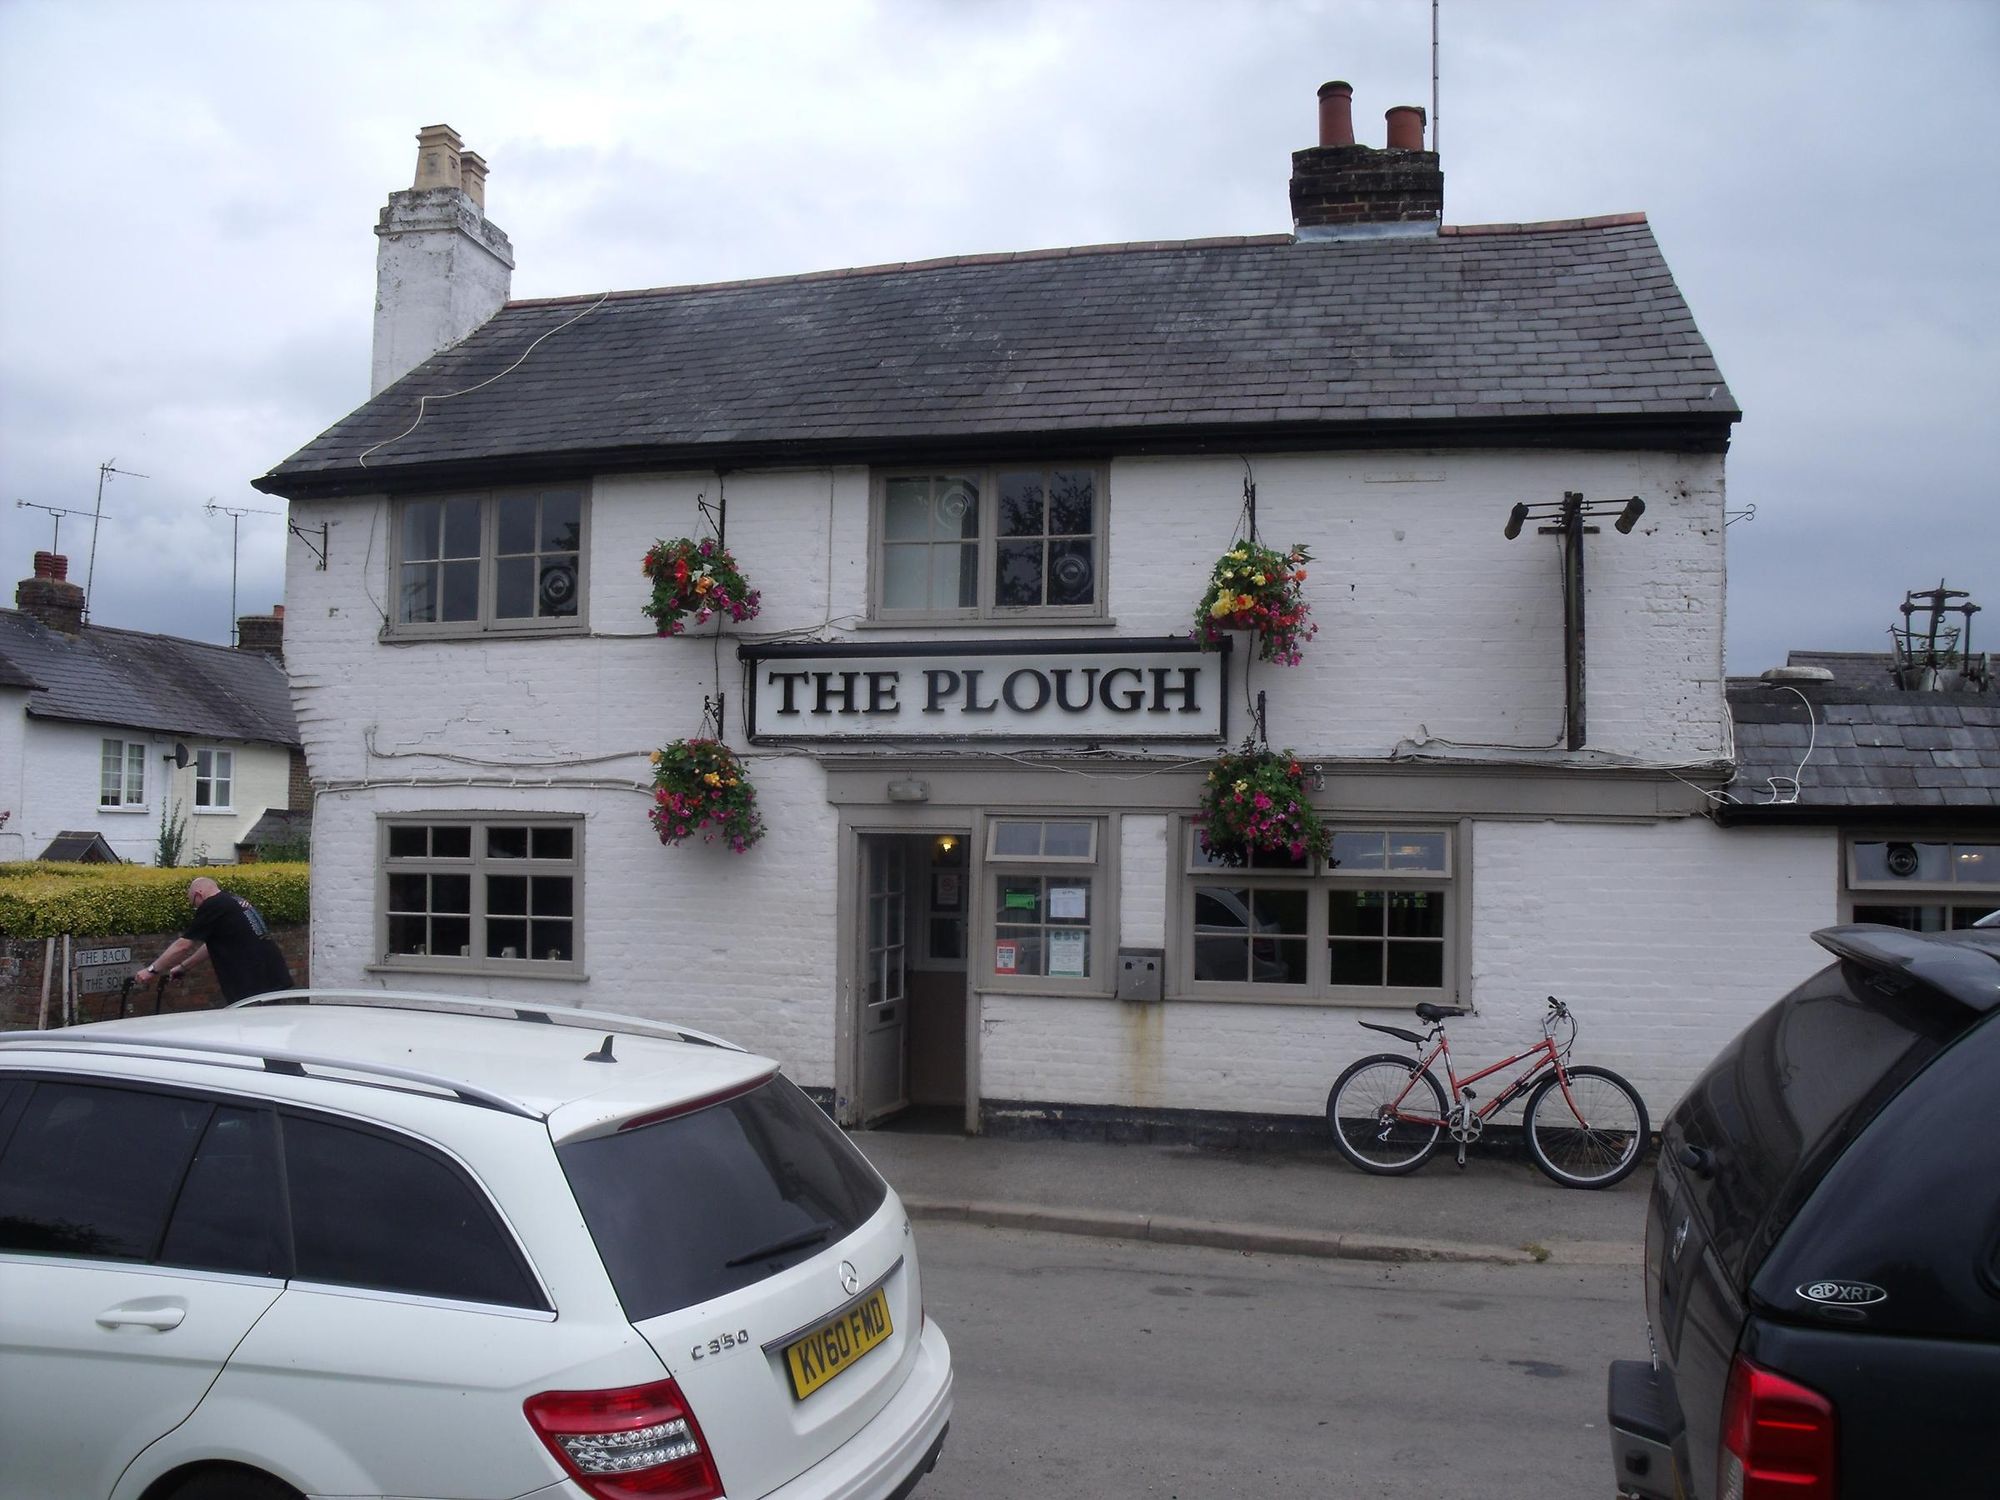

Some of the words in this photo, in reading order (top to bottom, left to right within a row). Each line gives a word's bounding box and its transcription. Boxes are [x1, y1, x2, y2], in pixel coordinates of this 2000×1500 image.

[768, 670, 901, 715] THE
[921, 667, 1201, 714] PLOUGH
[80, 952, 98, 964] THE
[102, 950, 127, 962] BACK
[85, 977, 104, 991] THE
[1838, 1286, 1876, 1301] XRT
[690, 1345, 705, 1361] C
[708, 1329, 750, 1356] 350
[797, 1320, 851, 1385] KV60
[849, 1298, 885, 1350] FMD
